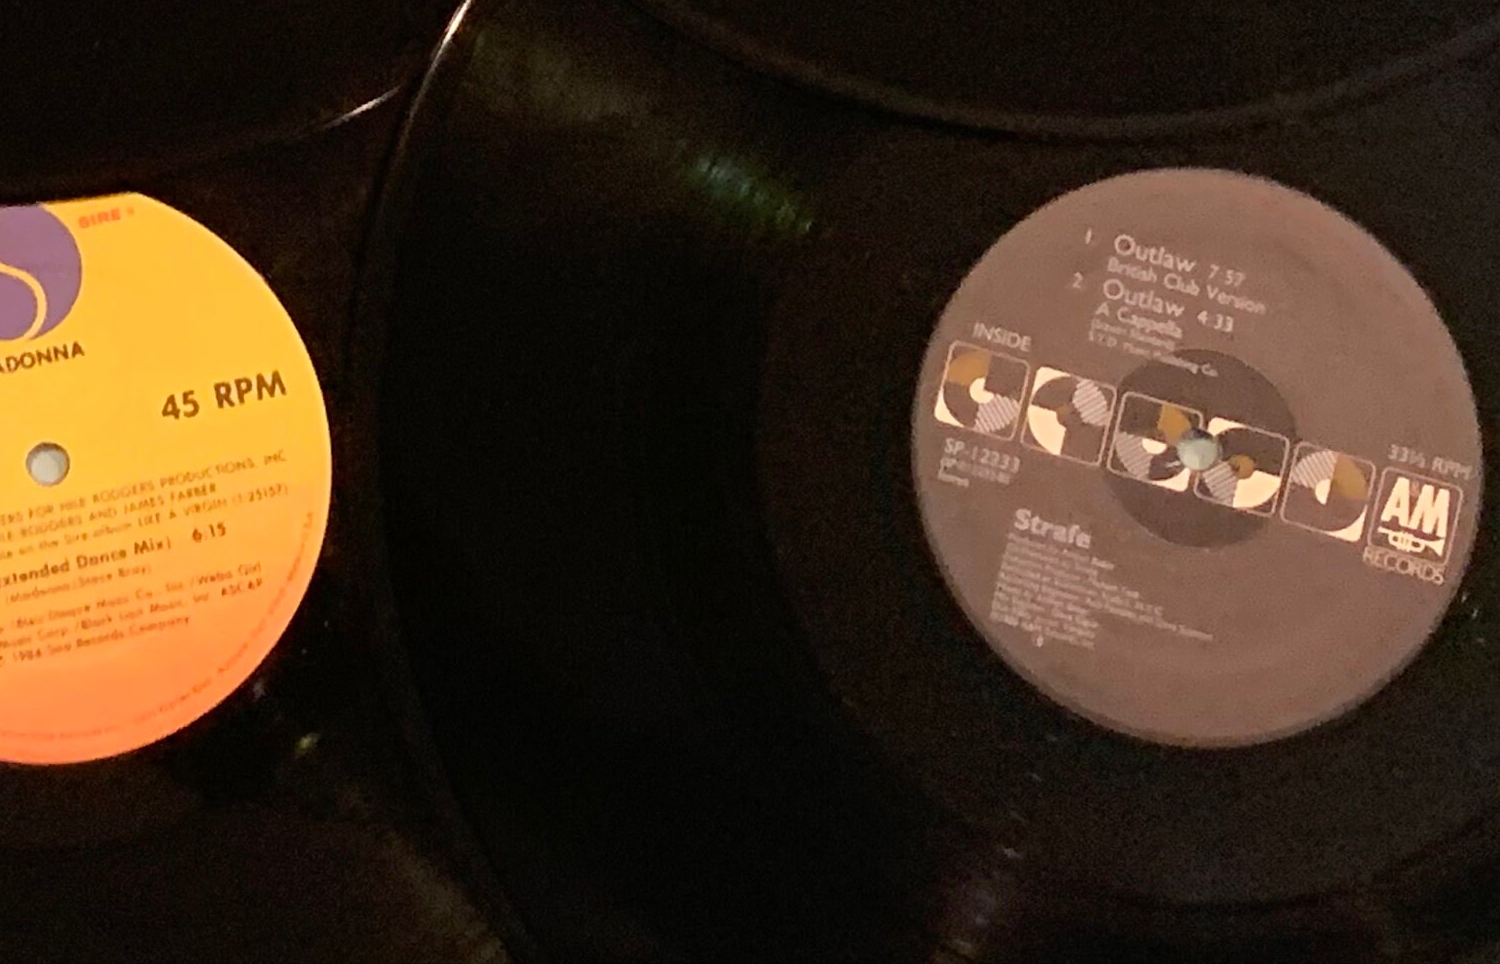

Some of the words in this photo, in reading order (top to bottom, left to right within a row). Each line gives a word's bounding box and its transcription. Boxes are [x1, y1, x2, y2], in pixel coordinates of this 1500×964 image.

[1113, 234, 1196, 273] Outlaw
[1073, 272, 1084, 289] 2
[1103, 278, 1185, 318] Outlaw
[1108, 257, 1157, 283] British
[1163, 273, 1200, 297] Club
[1206, 286, 1267, 315] Version
[1095, 302, 1110, 317] A
[973, 322, 1033, 352] INSIDE
[161, 390, 200, 420] 45
[214, 370, 287, 409] RPM
[1431, 457, 1474, 480] RPM
[1014, 508, 1092, 549] Strafe
[76, 548, 128, 570] Dance
[134, 537, 172, 556] Mix)
[1363, 546, 1444, 585] RECORDS
